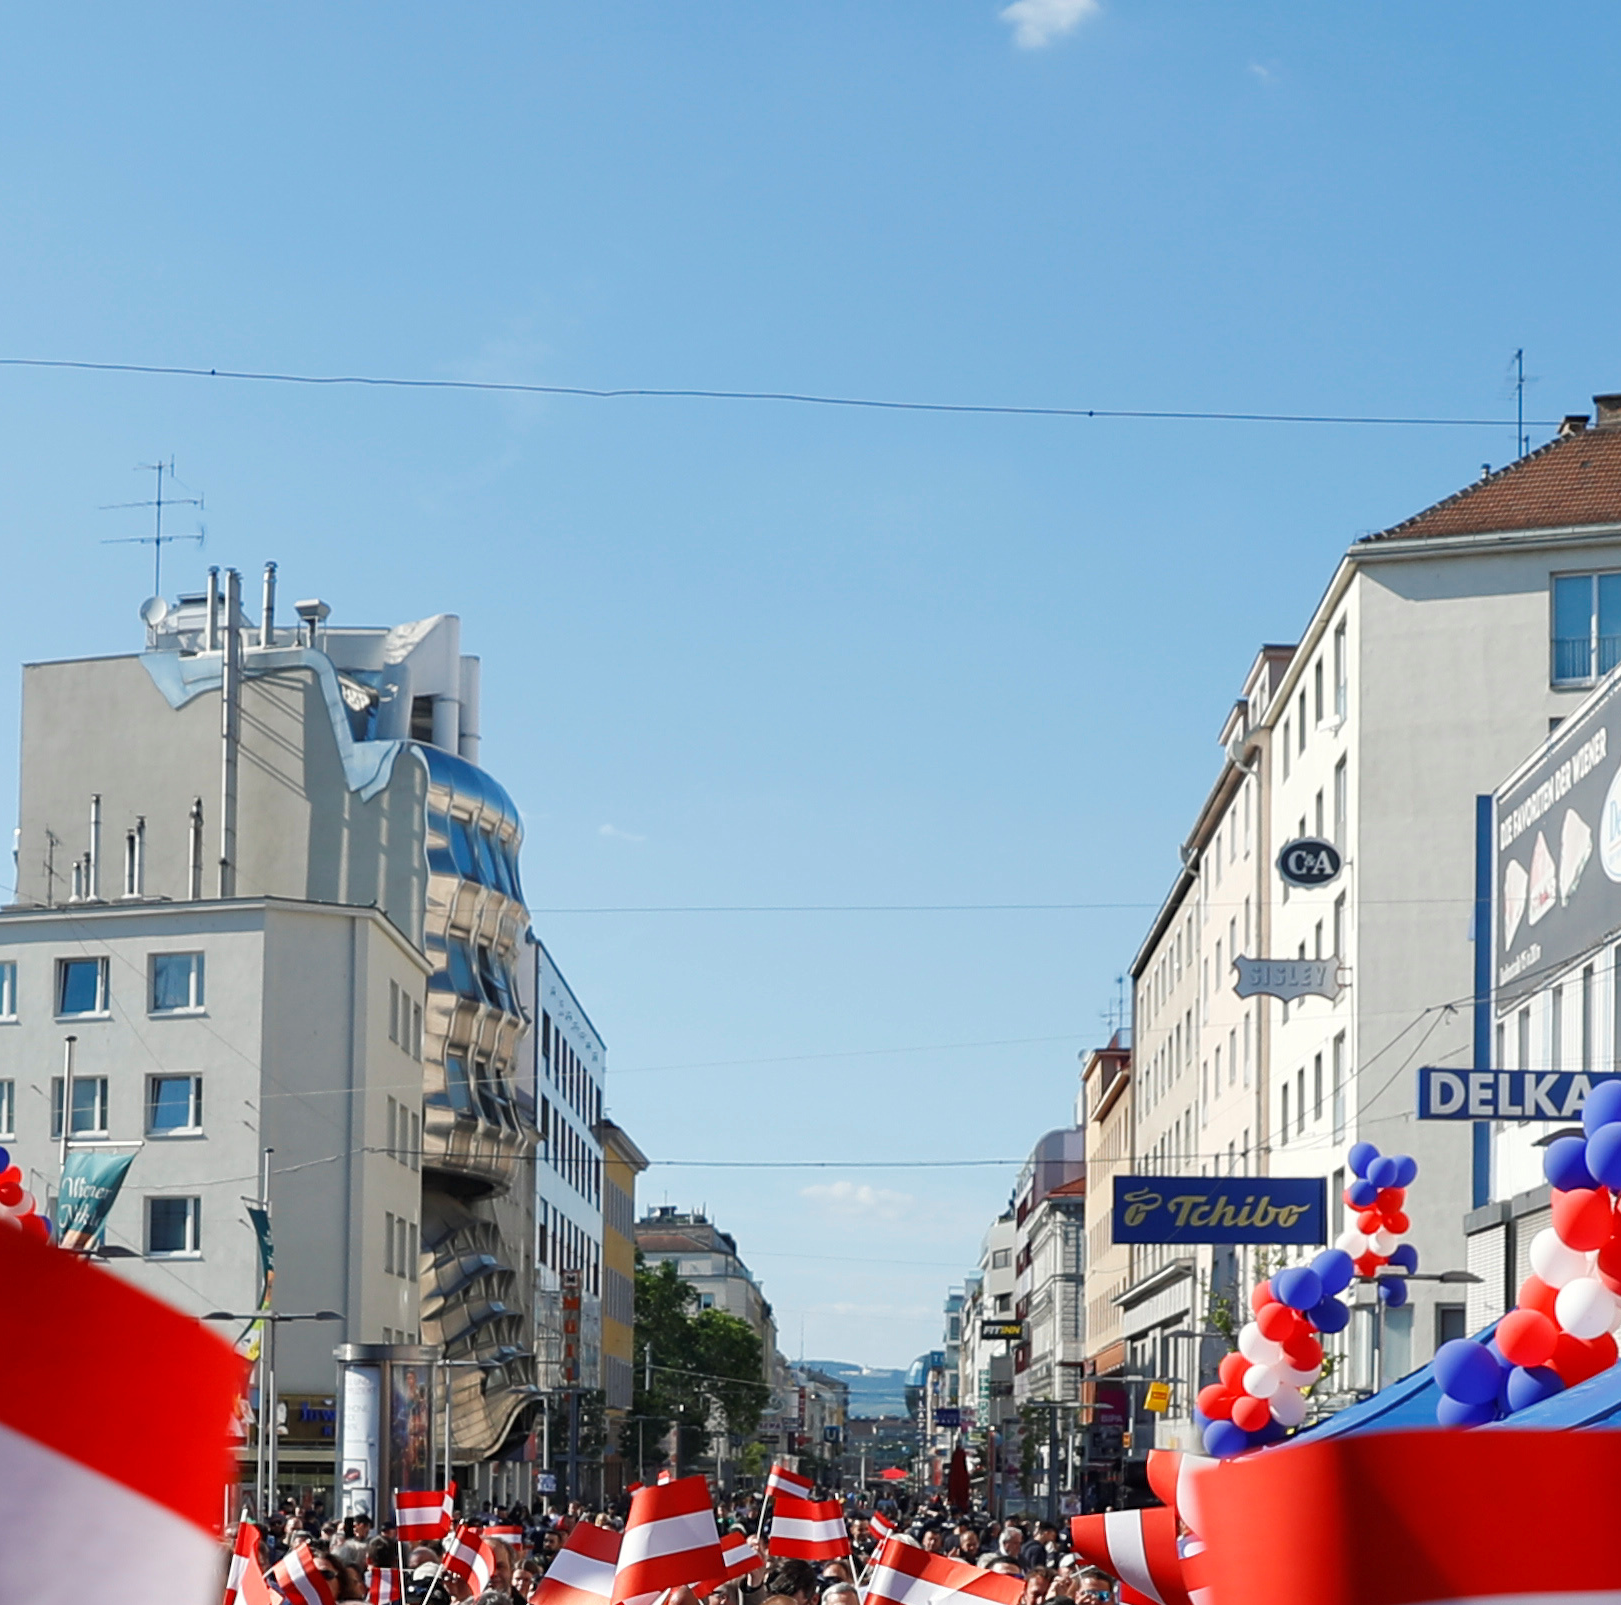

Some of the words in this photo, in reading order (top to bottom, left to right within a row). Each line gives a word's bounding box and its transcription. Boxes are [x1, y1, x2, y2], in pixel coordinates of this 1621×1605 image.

[1288, 850, 1335, 876] C&A
[1250, 966, 1327, 988] SISLEY
[1429, 1072, 1591, 1118] DELKA
[1167, 1191, 1311, 1229] Tchibo
